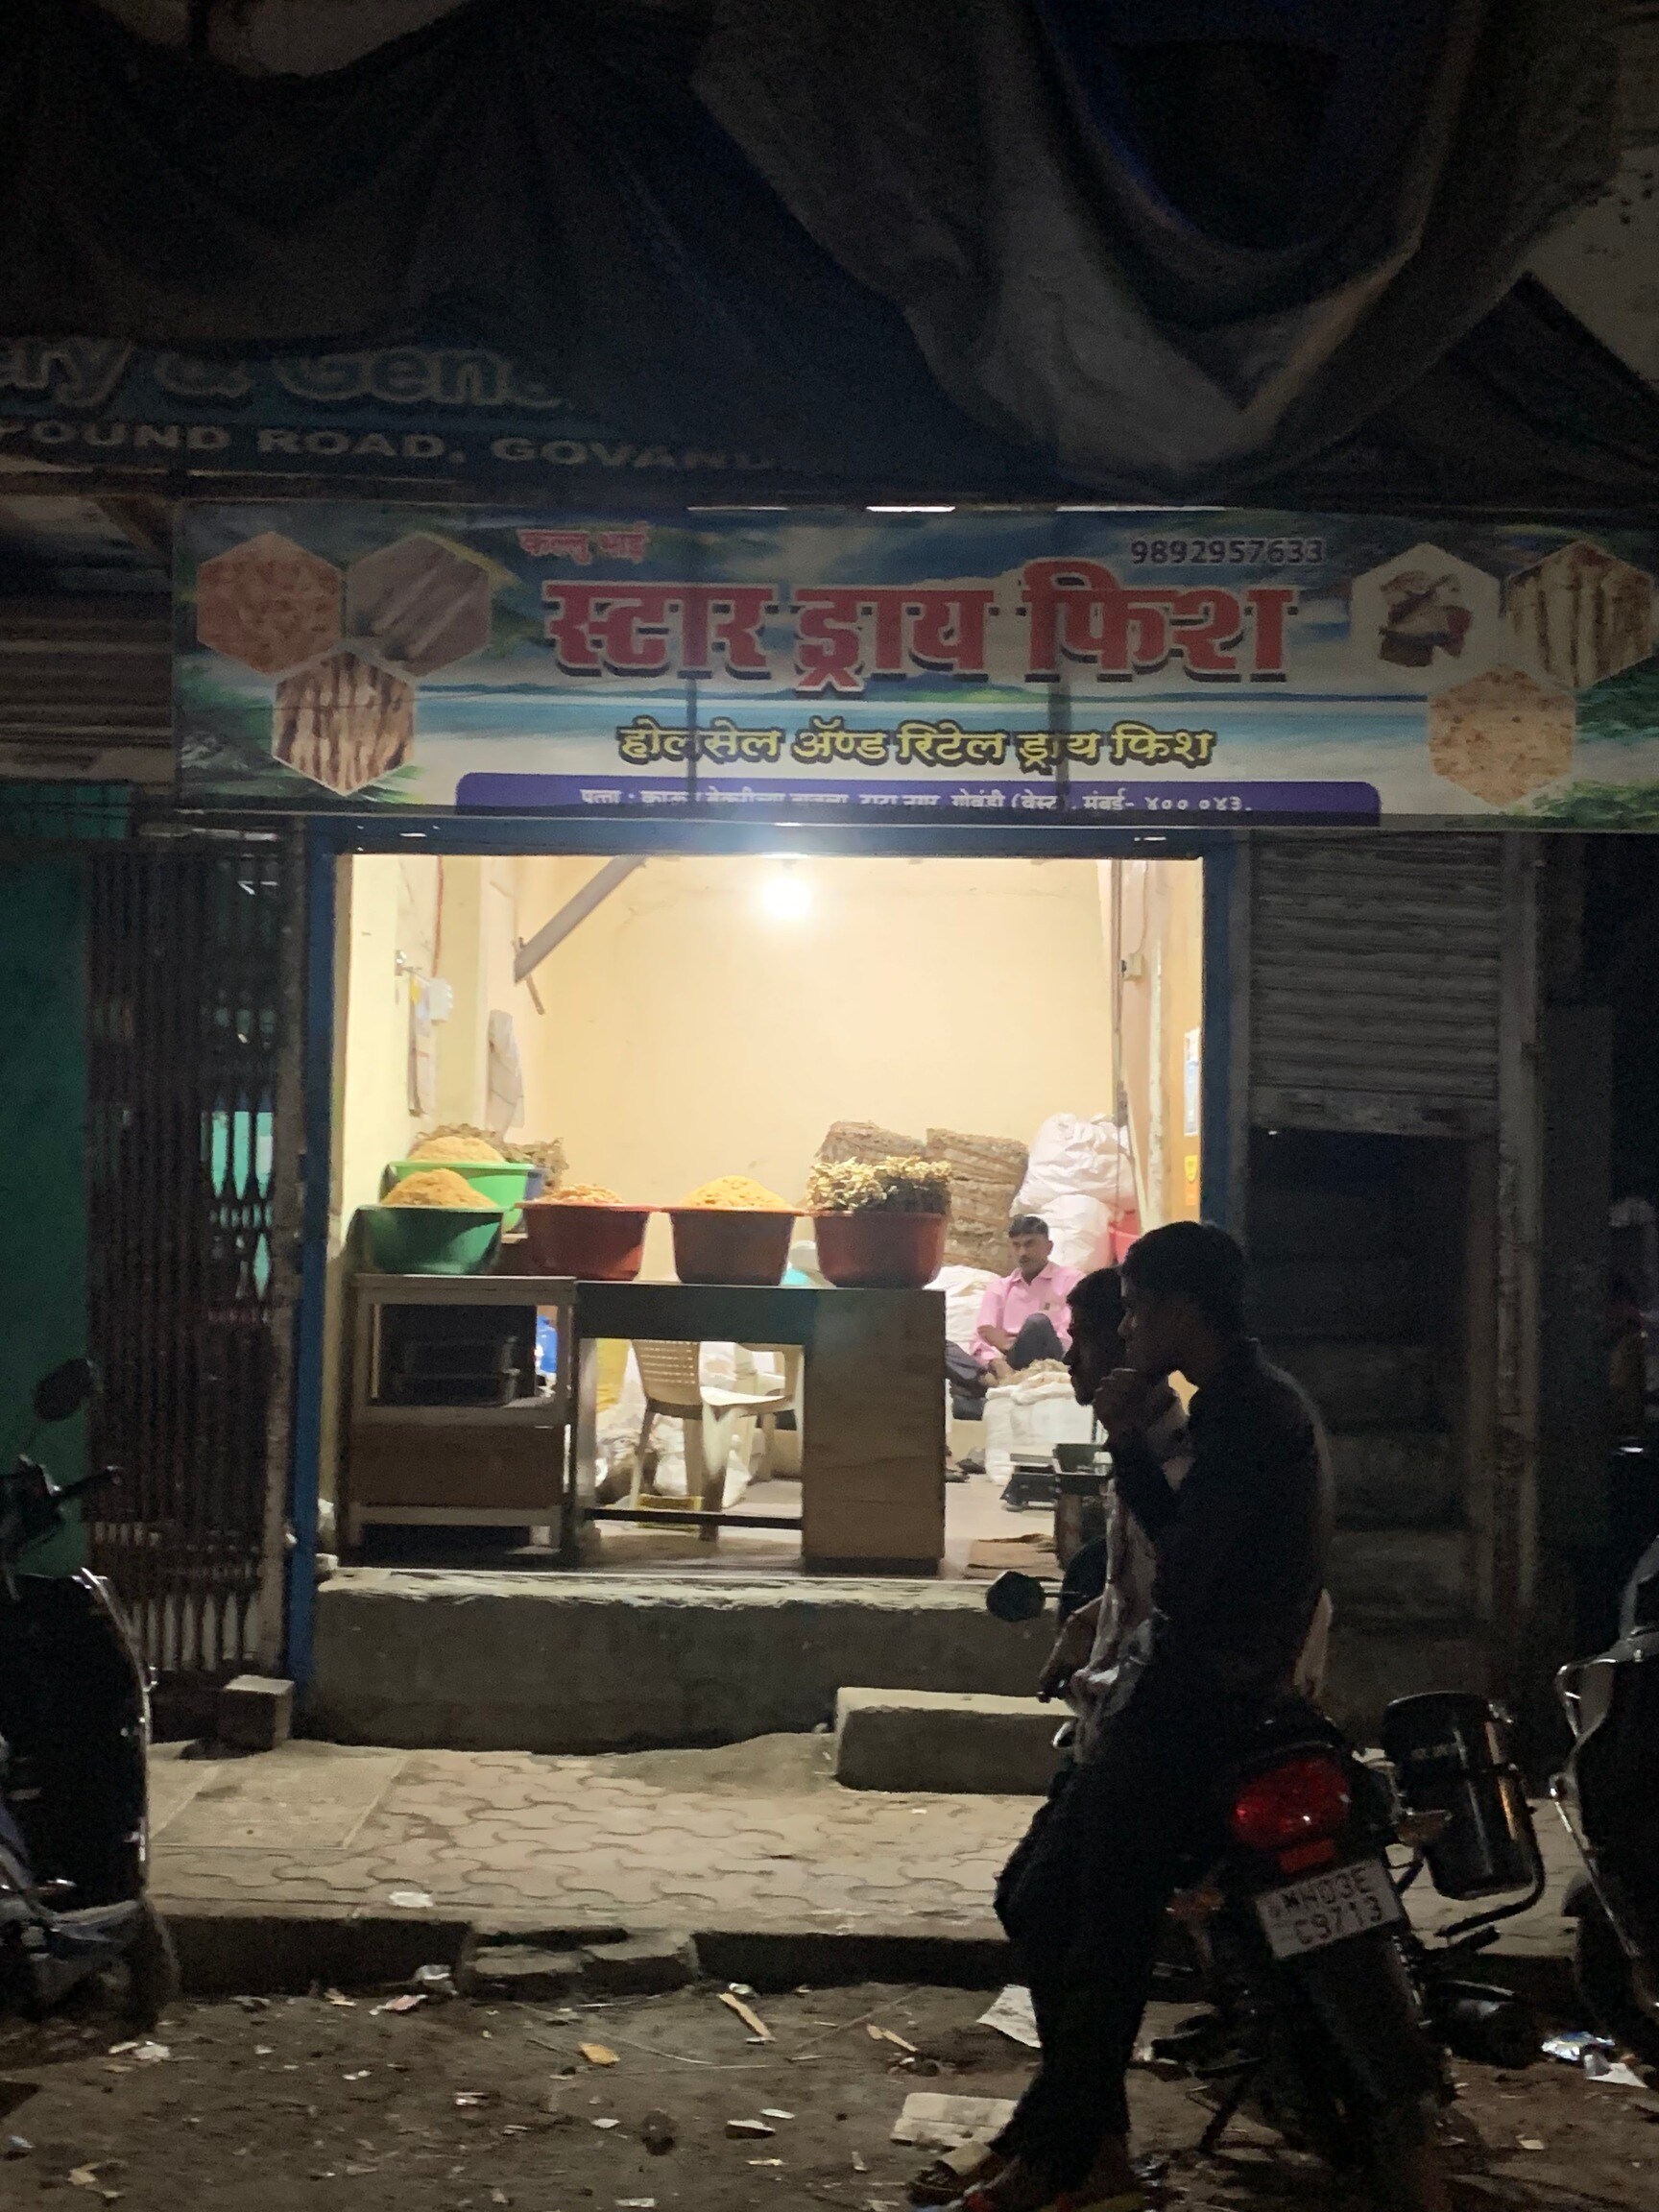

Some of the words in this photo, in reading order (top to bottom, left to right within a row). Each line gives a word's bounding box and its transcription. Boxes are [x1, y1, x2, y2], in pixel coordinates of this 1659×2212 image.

[1130, 537, 1325, 565] 9892957633
[541, 580, 780, 679] स्टार
[794, 584, 995, 698] ड्राय
[1022, 557, 1298, 683] फिश
[615, 714, 783, 766] होलसेल
[895, 719, 1006, 766] रिटेल
[1014, 727, 1101, 775] ड्राय
[1111, 719, 1216, 769] फिश
